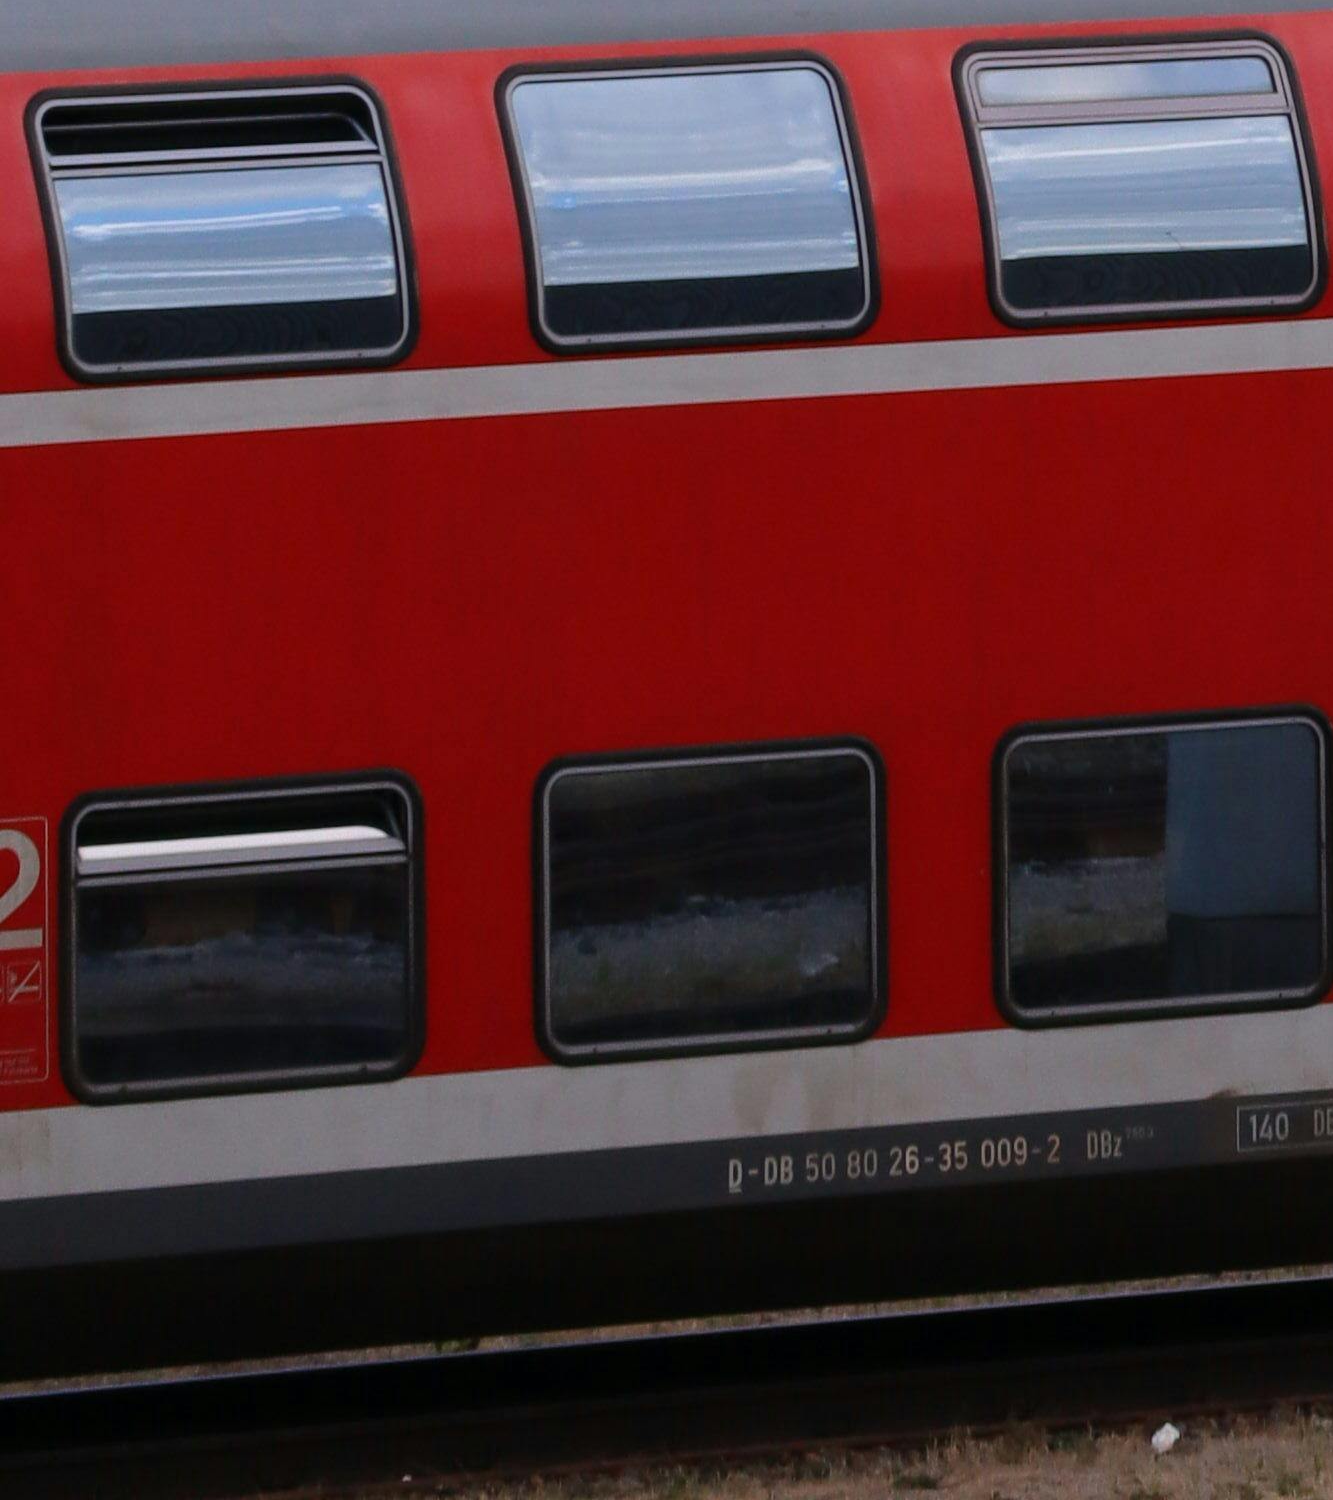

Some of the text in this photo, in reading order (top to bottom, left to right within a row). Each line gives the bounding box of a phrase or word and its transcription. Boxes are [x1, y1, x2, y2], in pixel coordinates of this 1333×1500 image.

[1248, 1111, 1290, 1143] 140
[805, 1148, 837, 1182] 50
[847, 1146, 879, 1178] 80
[888, 1141, 969, 1176] 26-35
[979, 1133, 1062, 1167] 009-2
